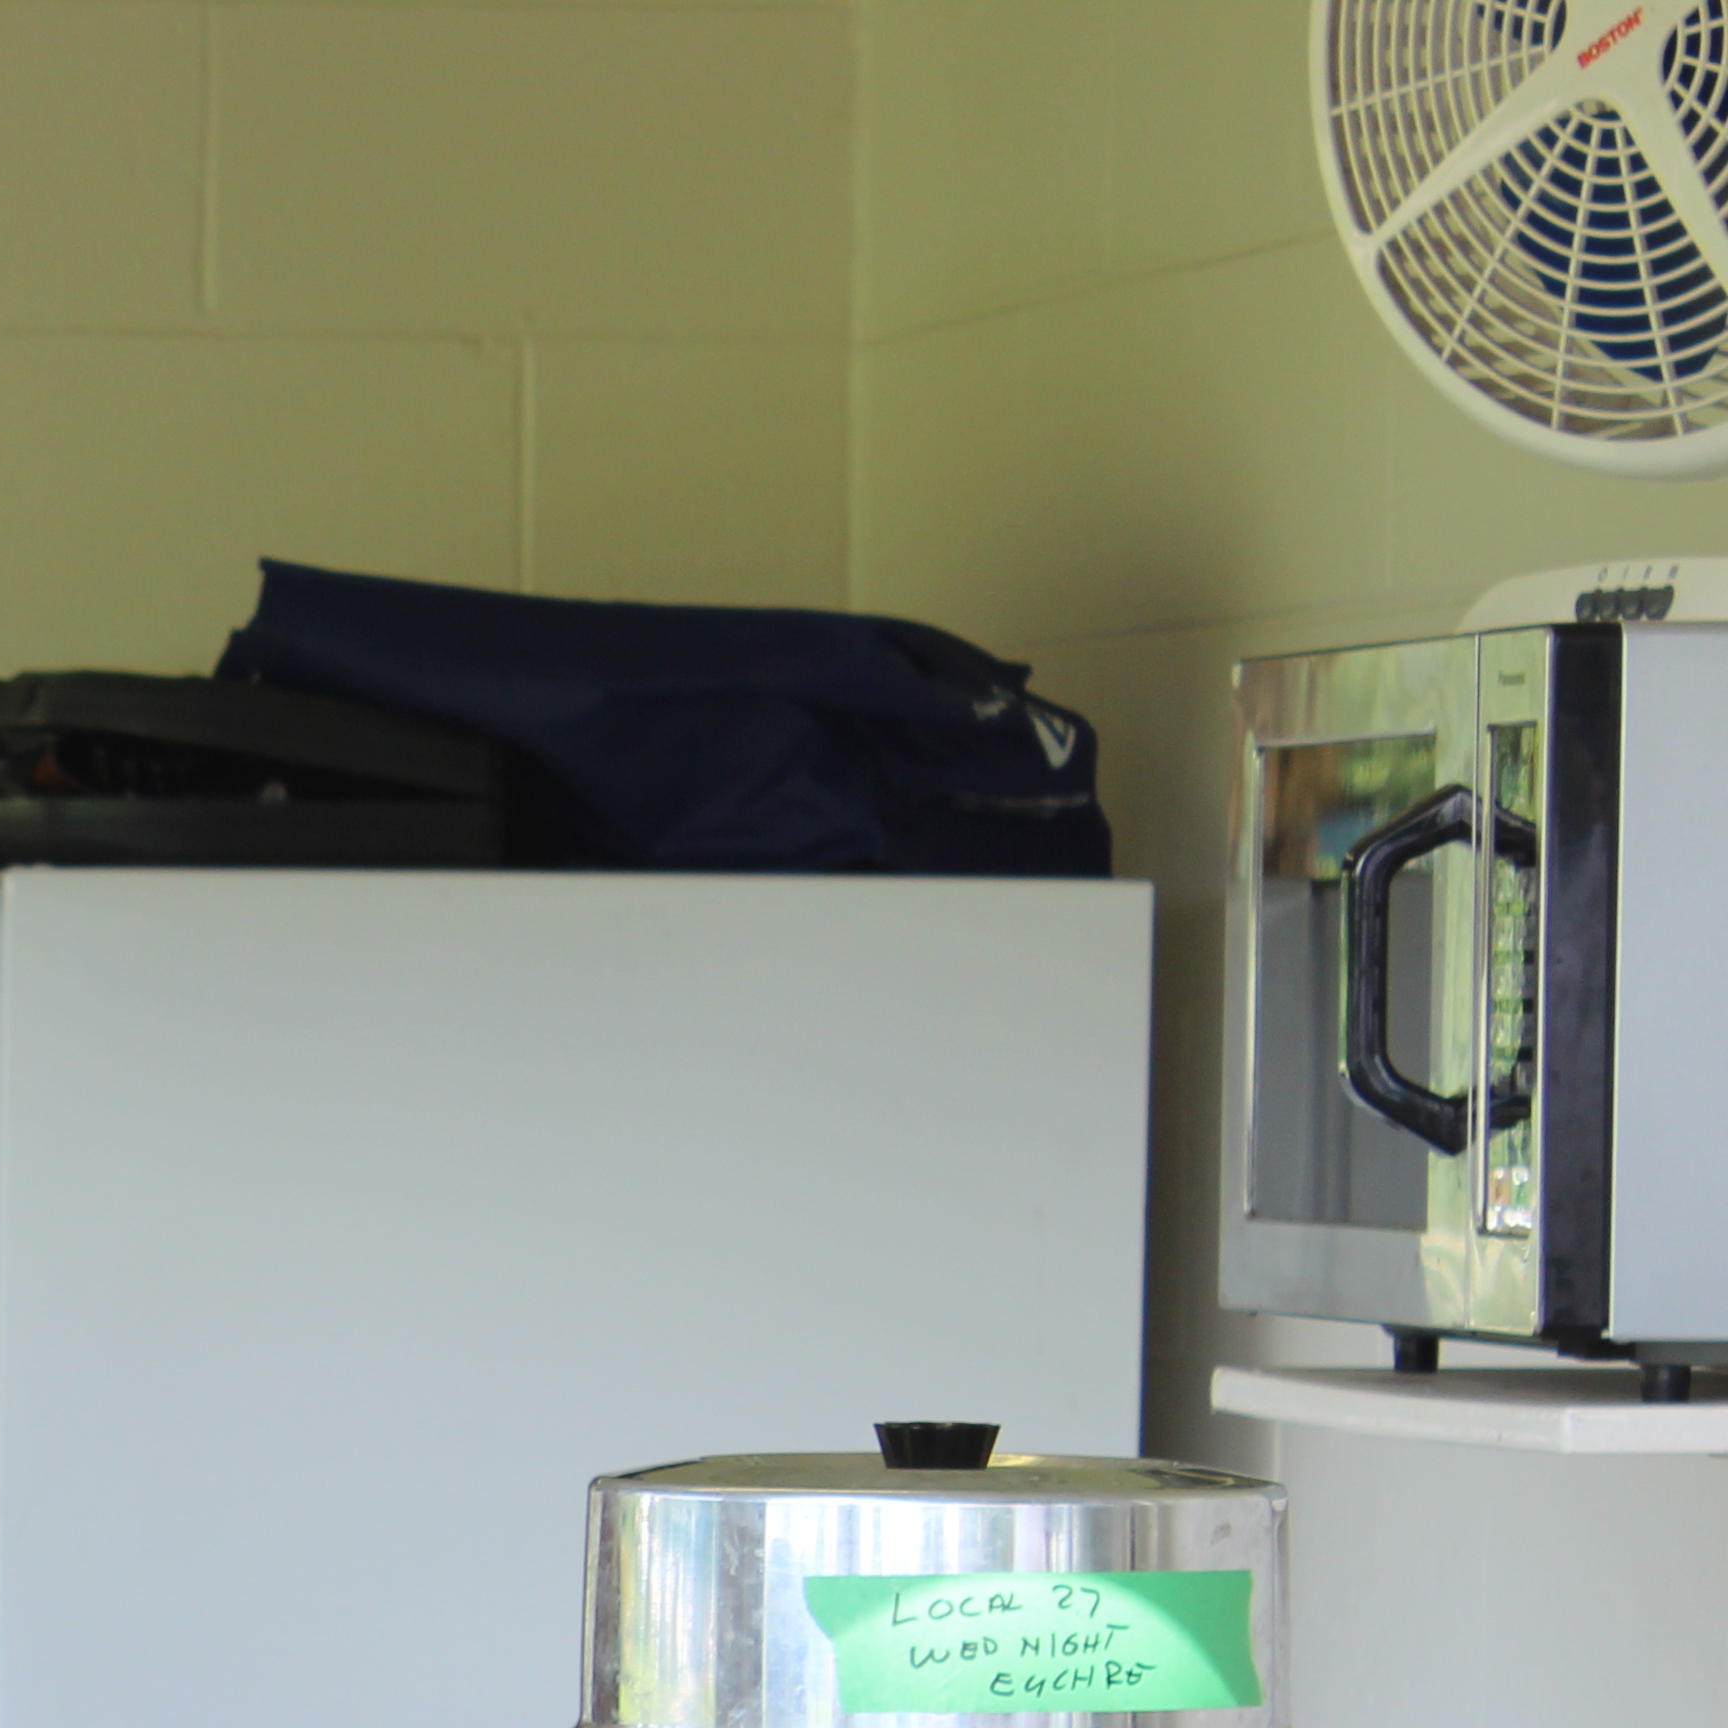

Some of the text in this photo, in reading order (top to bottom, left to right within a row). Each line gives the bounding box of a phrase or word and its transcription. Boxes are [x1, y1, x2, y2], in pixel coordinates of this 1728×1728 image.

[891, 1584, 1102, 1627] LOCAL 27
[910, 1623, 1130, 1669] WED NIGHT
[990, 1662, 1157, 1697] EUCHRE
